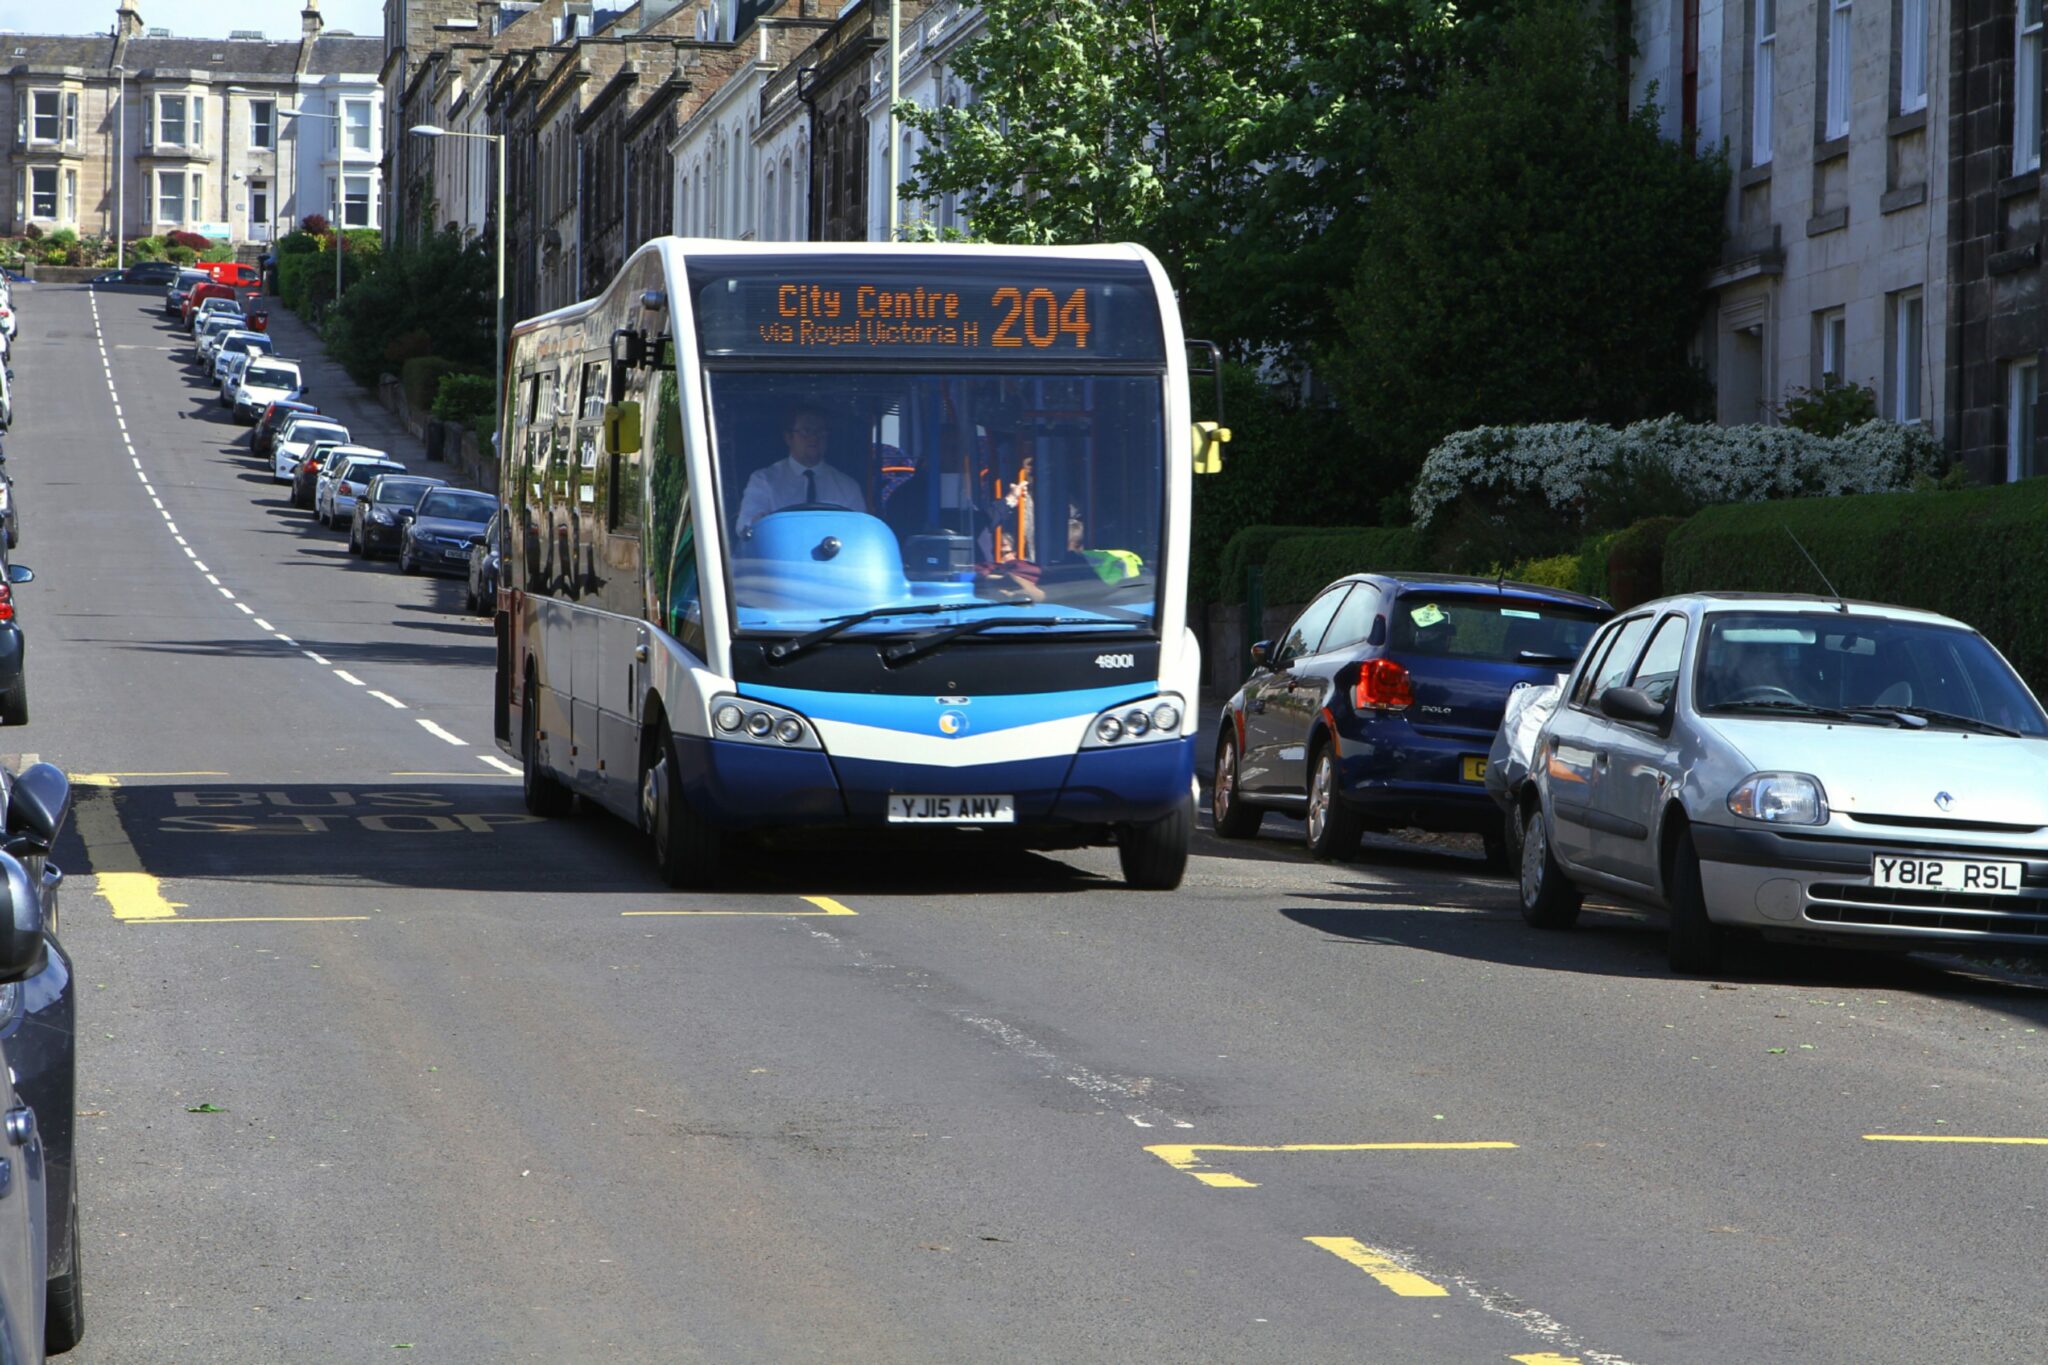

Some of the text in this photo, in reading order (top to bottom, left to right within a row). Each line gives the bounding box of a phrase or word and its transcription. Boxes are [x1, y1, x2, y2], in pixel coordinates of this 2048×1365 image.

[778, 285, 959, 318] City Centre
[991, 287, 1091, 348] 204
[759, 319, 979, 347] via Royal Victoria H
[1420, 705, 1452, 714] POLO
[172, 790, 455, 808] BUS
[901, 798, 1001, 818] YJ15 AMV
[157, 813, 549, 833] STOP
[1879, 859, 2018, 891] Y812 RSL
